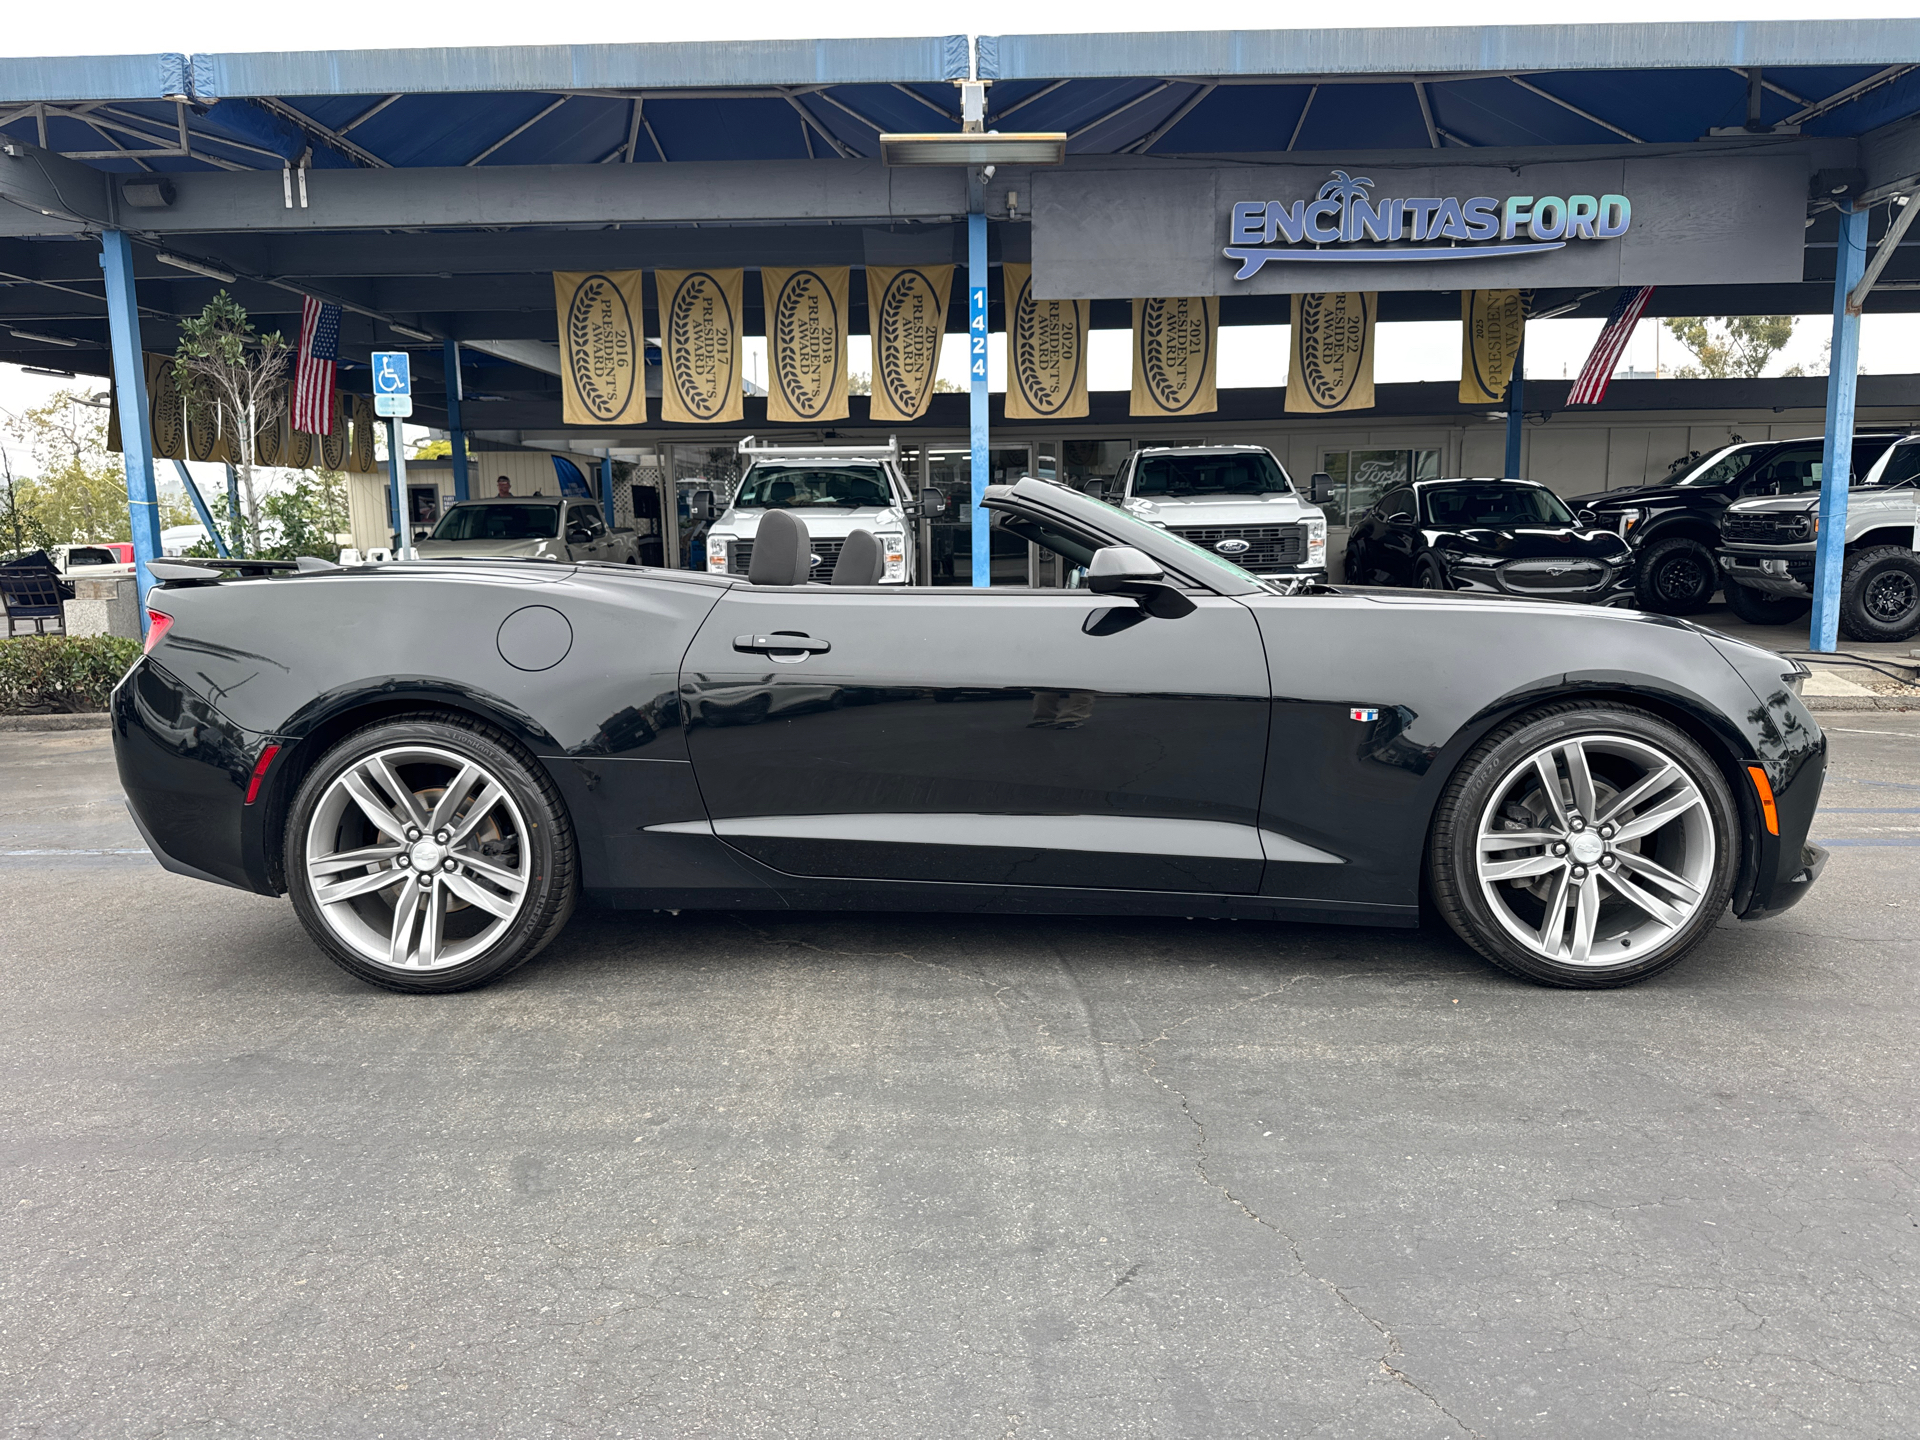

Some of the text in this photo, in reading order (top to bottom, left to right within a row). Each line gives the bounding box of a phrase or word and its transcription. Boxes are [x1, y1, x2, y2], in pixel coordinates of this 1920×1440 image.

[1231, 194, 1632, 245] ENCINITAS FORD
[592, 322, 605, 378] AWARD
[600, 298, 618, 401] PRESIDENT'S
[615, 330, 629, 368] 2016
[692, 319, 705, 376] AWARD
[702, 296, 717, 399] PRESIDENT'S
[715, 328, 729, 366] 2017
[797, 319, 810, 376] AWARD
[807, 294, 820, 398] PRESIDENT'S
[821, 327, 833, 364] 2018
[902, 317, 913, 374] AWARD
[972, 290, 986, 376] 1424
[1038, 314, 1049, 371] AWARD
[1049, 300, 1060, 394] RESIDENT'S
[1061, 322, 1074, 361] 2020
[1166, 311, 1177, 368] AWARD
[1177, 298, 1188, 391] RESIDENT'S
[1189, 319, 1201, 356] 2021
[1322, 308, 1334, 365] AWARD
[1333, 292, 1346, 387] RESIDENT'S
[1346, 316, 1359, 353] 2022
[1476, 319, 1484, 339] 2025
[1487, 289, 1502, 387] PRESIDENT
[1504, 295, 1519, 360] AWARD
[1354, 460, 1406, 483] Ford
[452, 733, 495, 757] LIONHART
[521, 894, 547, 939] LH-FIVE
